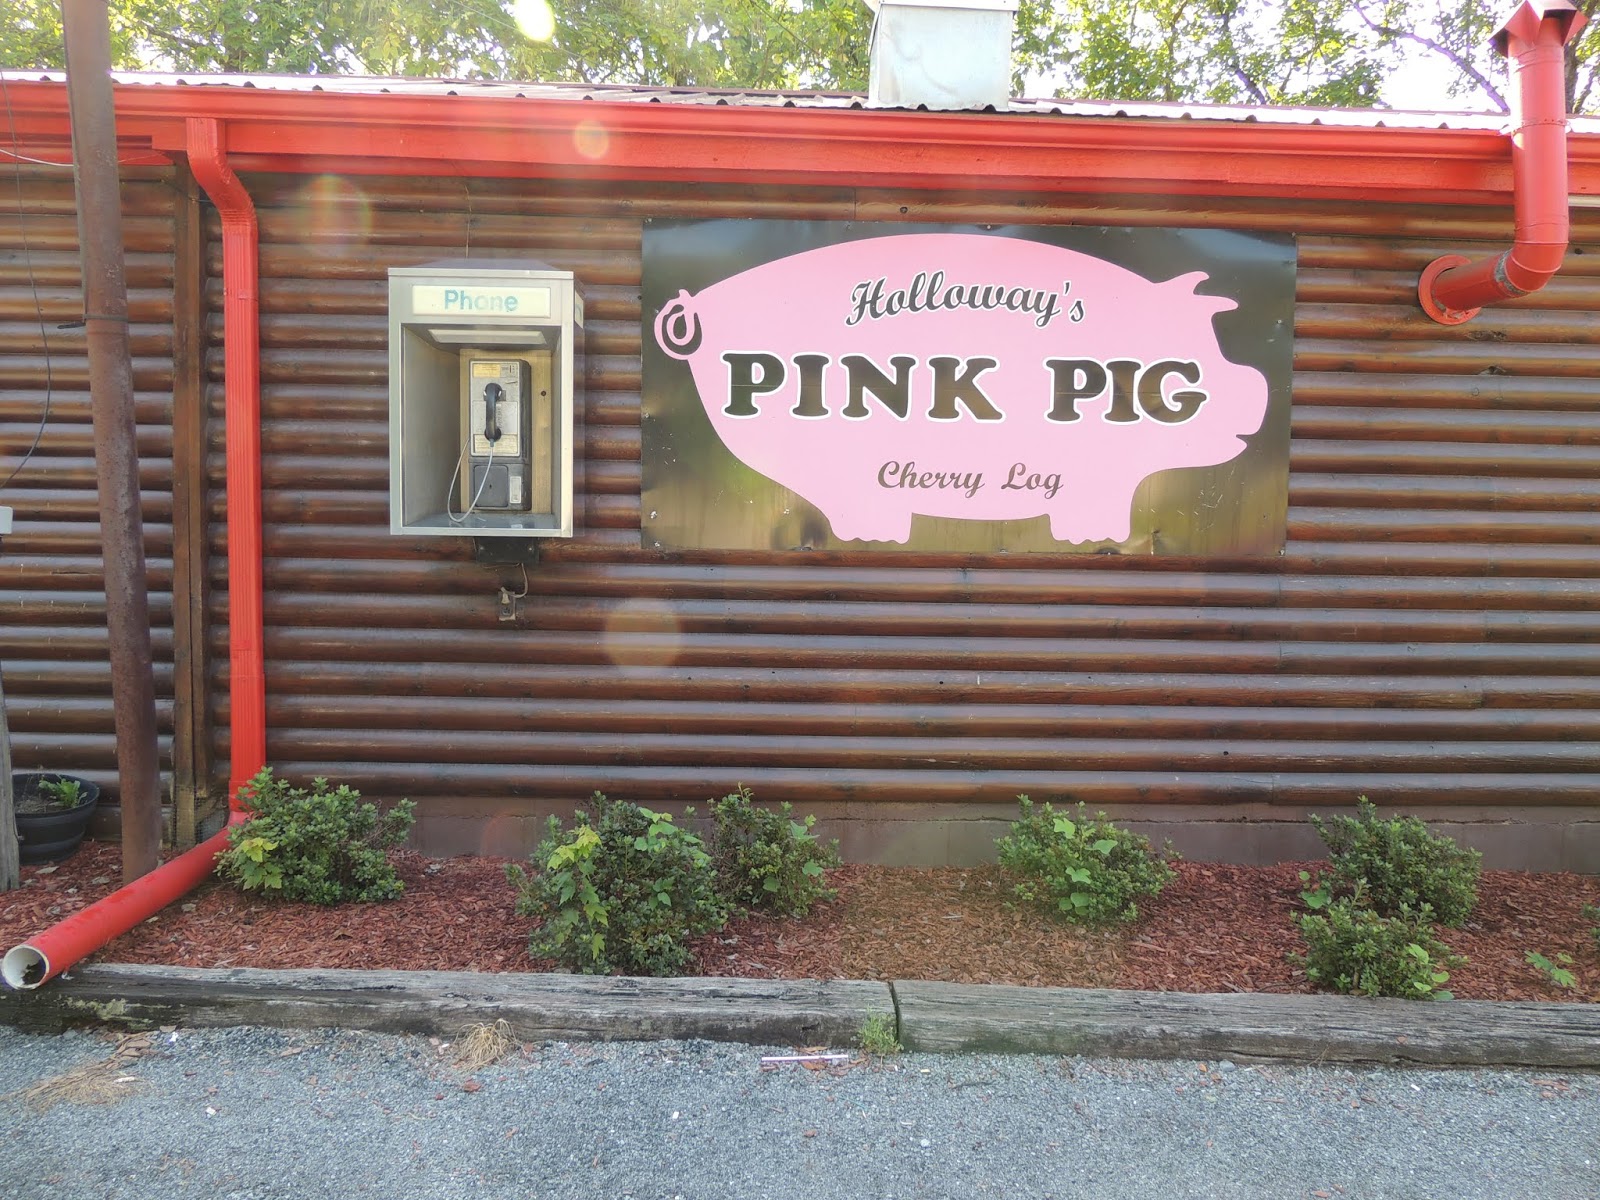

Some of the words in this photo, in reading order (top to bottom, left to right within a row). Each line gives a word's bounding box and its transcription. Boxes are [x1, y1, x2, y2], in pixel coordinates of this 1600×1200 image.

[444, 289, 518, 311] Phone
[846, 271, 1085, 327] Holloway's
[721, 351, 1005, 422] PINK
[1044, 357, 1209, 425] PIG
[877, 461, 984, 498] Cherry
[1001, 462, 1064, 498] Log
